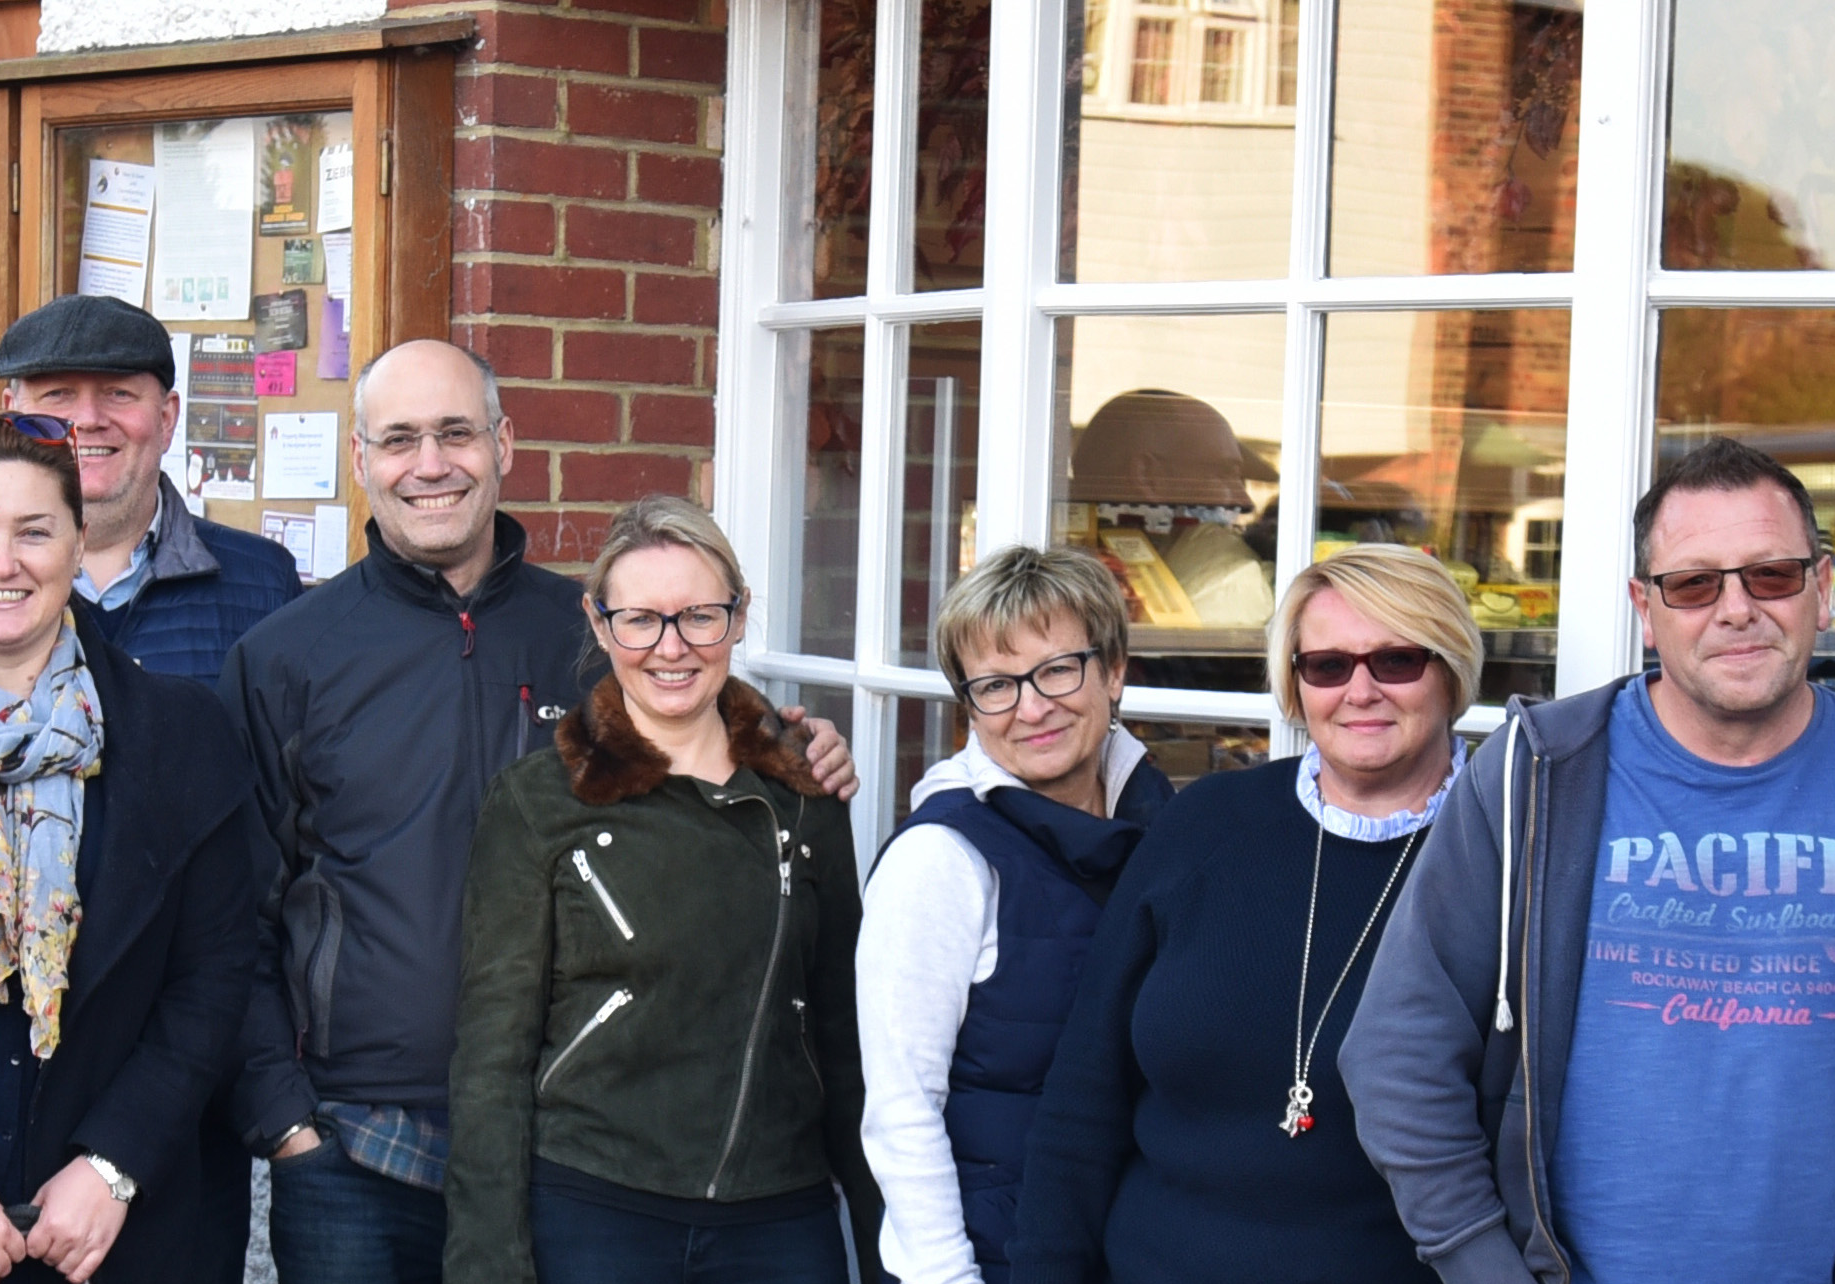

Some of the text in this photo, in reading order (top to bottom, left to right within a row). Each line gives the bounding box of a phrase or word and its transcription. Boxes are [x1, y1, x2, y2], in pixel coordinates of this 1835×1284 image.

[1607, 892, 1717, 928] Crafted
[1586, 939, 1641, 964] TIME
[1651, 946, 1740, 974] TESTED
[1749, 955, 1821, 975] SINCE
[1631, 971, 1717, 992] ROCKAWAY
[1722, 978, 1777, 995] BEACH
[1781, 980, 1803, 995] CA
[1661, 993, 1814, 1031] California
